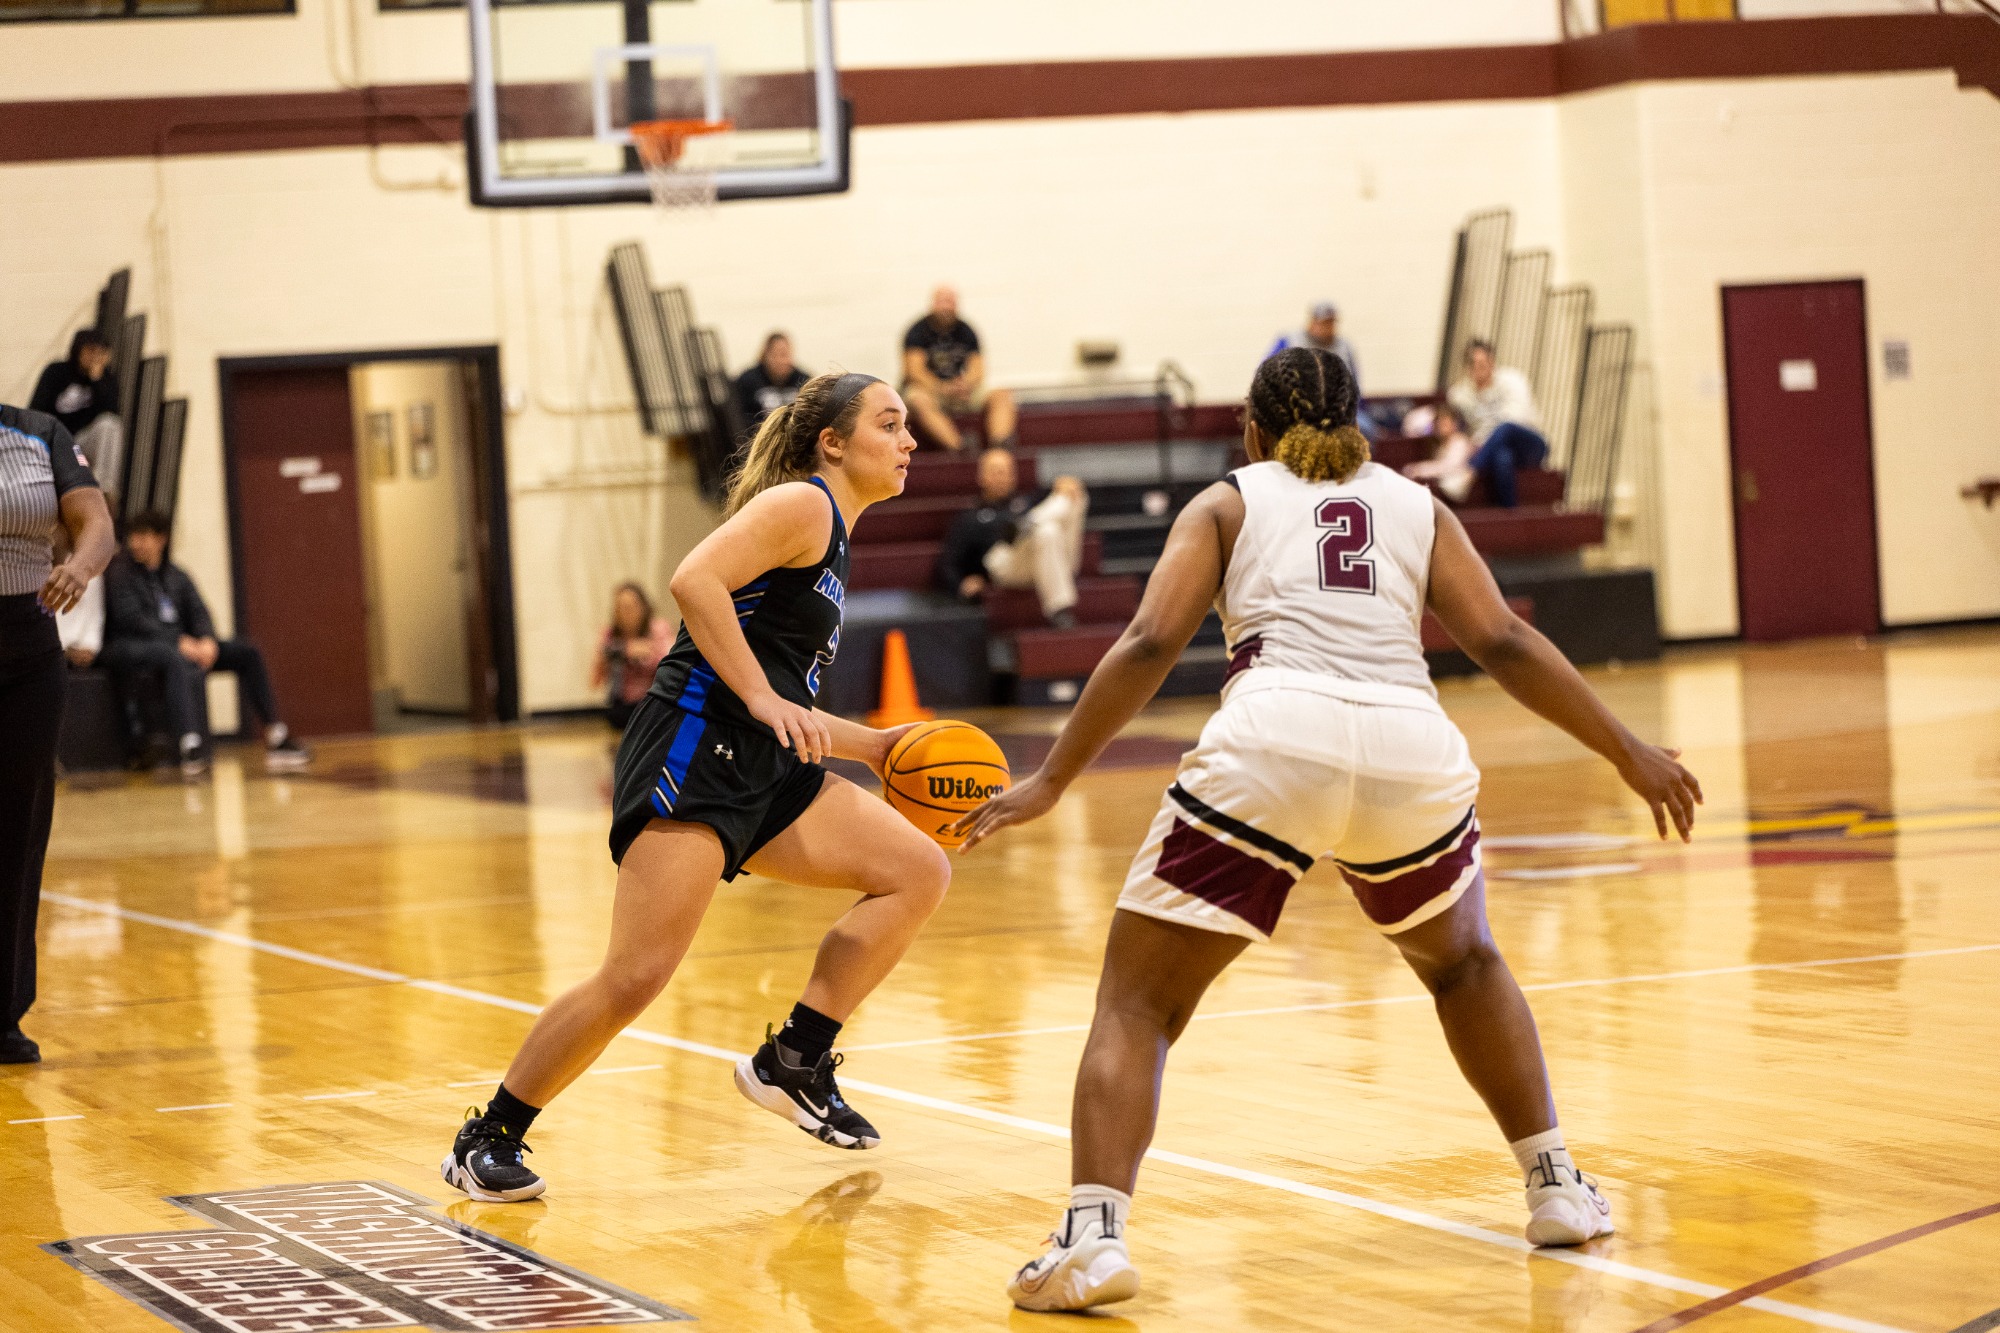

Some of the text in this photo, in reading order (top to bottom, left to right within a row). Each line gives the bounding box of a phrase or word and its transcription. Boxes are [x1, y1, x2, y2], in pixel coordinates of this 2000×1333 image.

[1314, 497, 1376, 596] 2
[83, 1231, 419, 1333] COLLEGE
[205, 1183, 663, 1331] WASHINGTON
